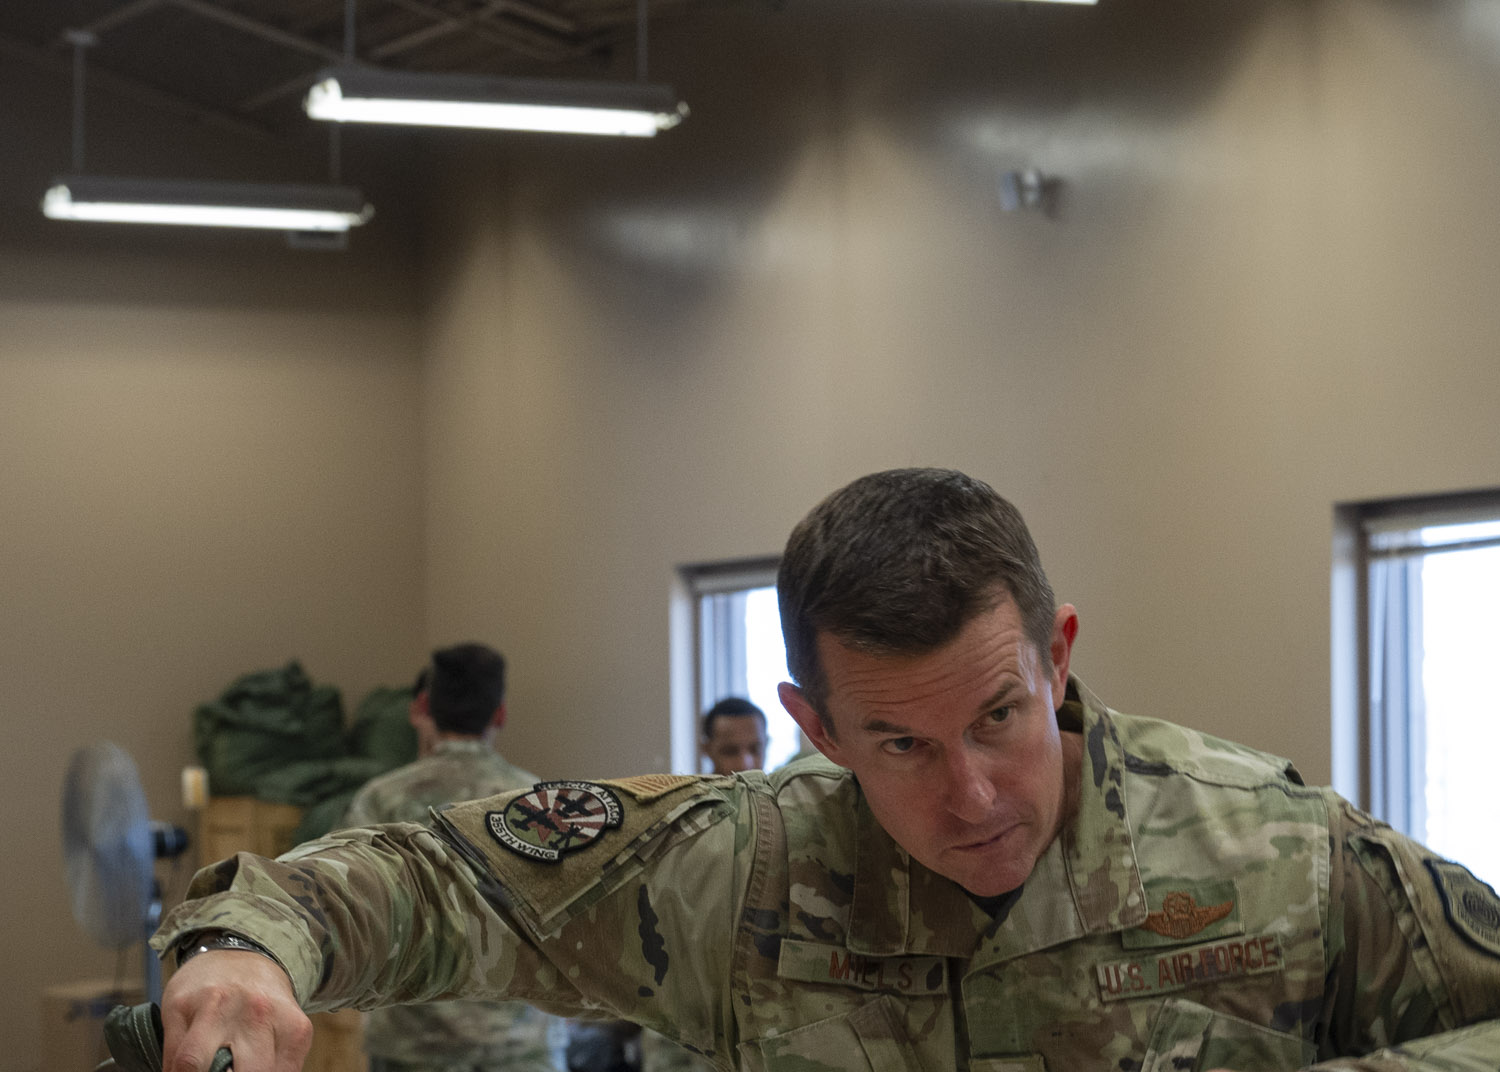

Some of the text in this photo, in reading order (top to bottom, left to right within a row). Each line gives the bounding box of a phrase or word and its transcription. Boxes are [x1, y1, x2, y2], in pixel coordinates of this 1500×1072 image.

[596, 789, 620, 826] ATTACK
[491, 816, 556, 859] 355TH WING
[1105, 937, 1280, 995] U.S. AIR FORCE
